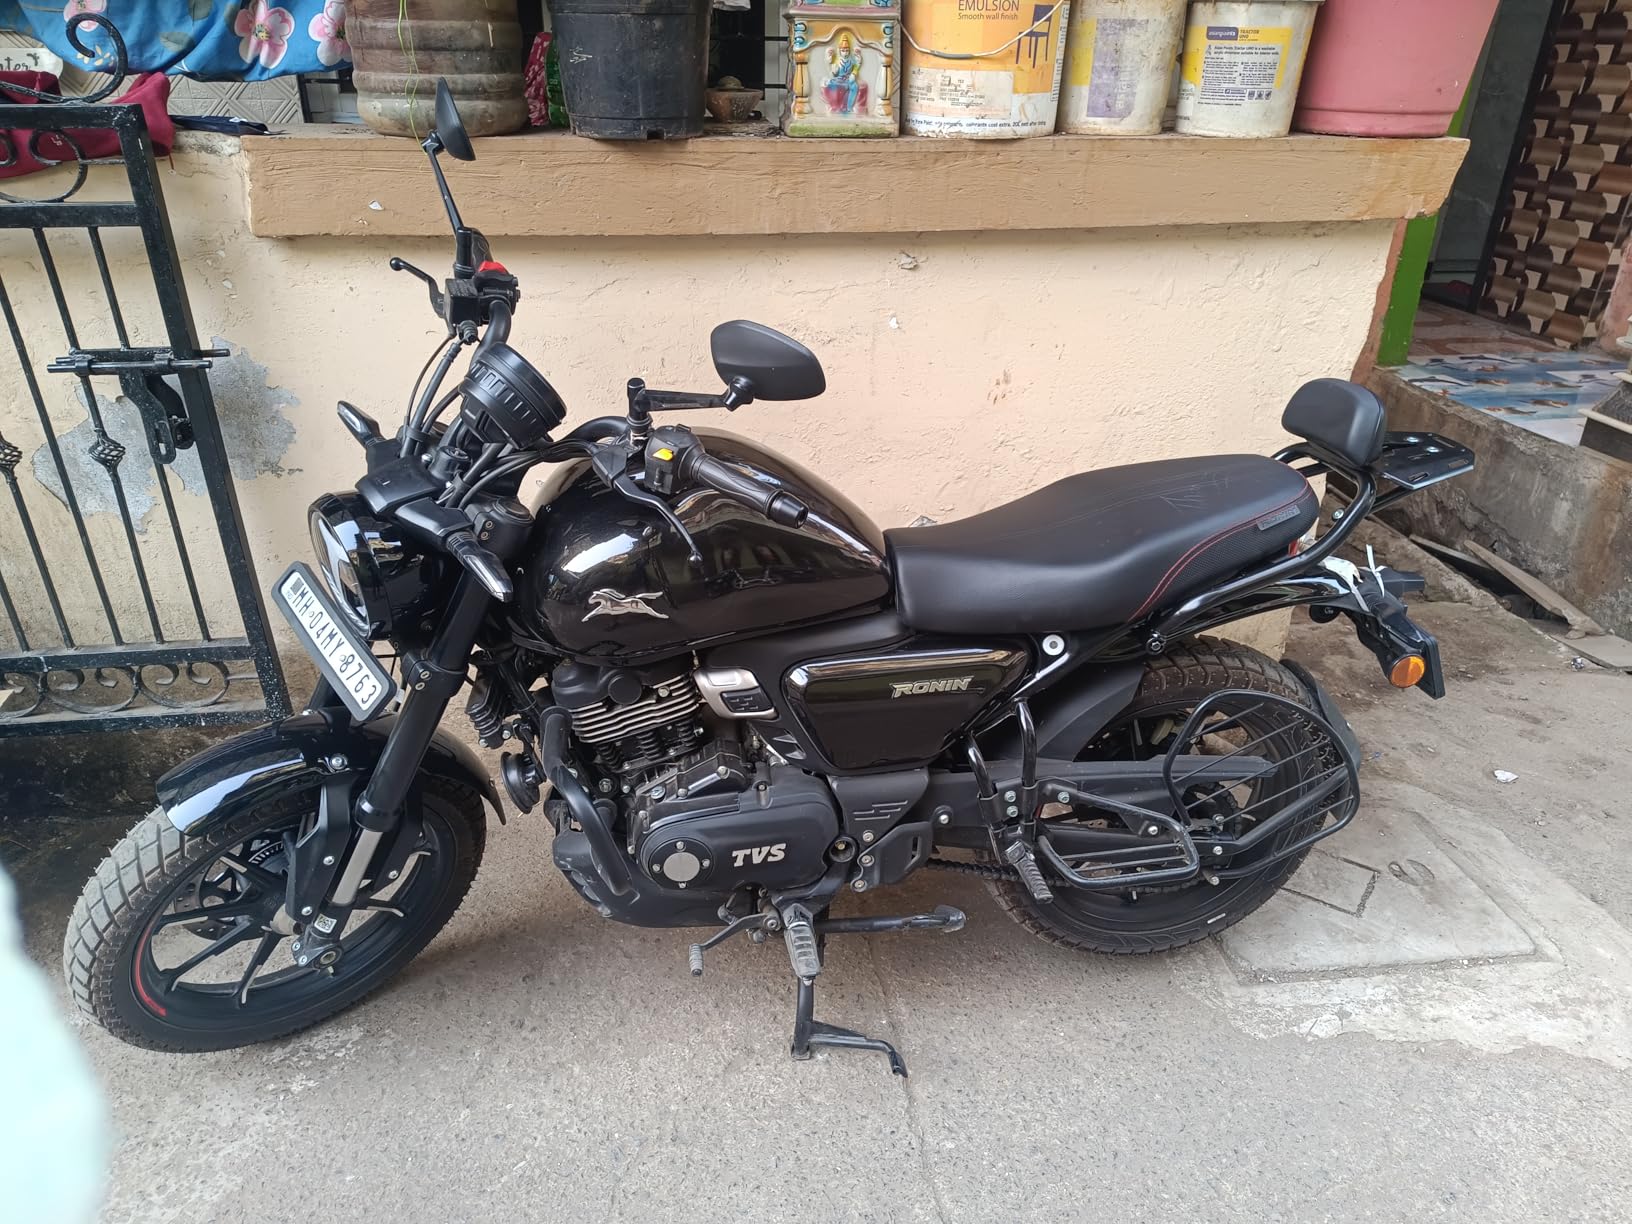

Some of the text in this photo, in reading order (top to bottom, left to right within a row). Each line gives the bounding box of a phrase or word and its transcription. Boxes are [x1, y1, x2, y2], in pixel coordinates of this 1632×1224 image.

[958, 0, 1019, 12] EMULSION
[958, 12, 1018, 20] Smooth wall finish
[339, 653, 377, 704] 8763
[890, 676, 974, 699] RONIN
[732, 843, 786, 867] TVS
